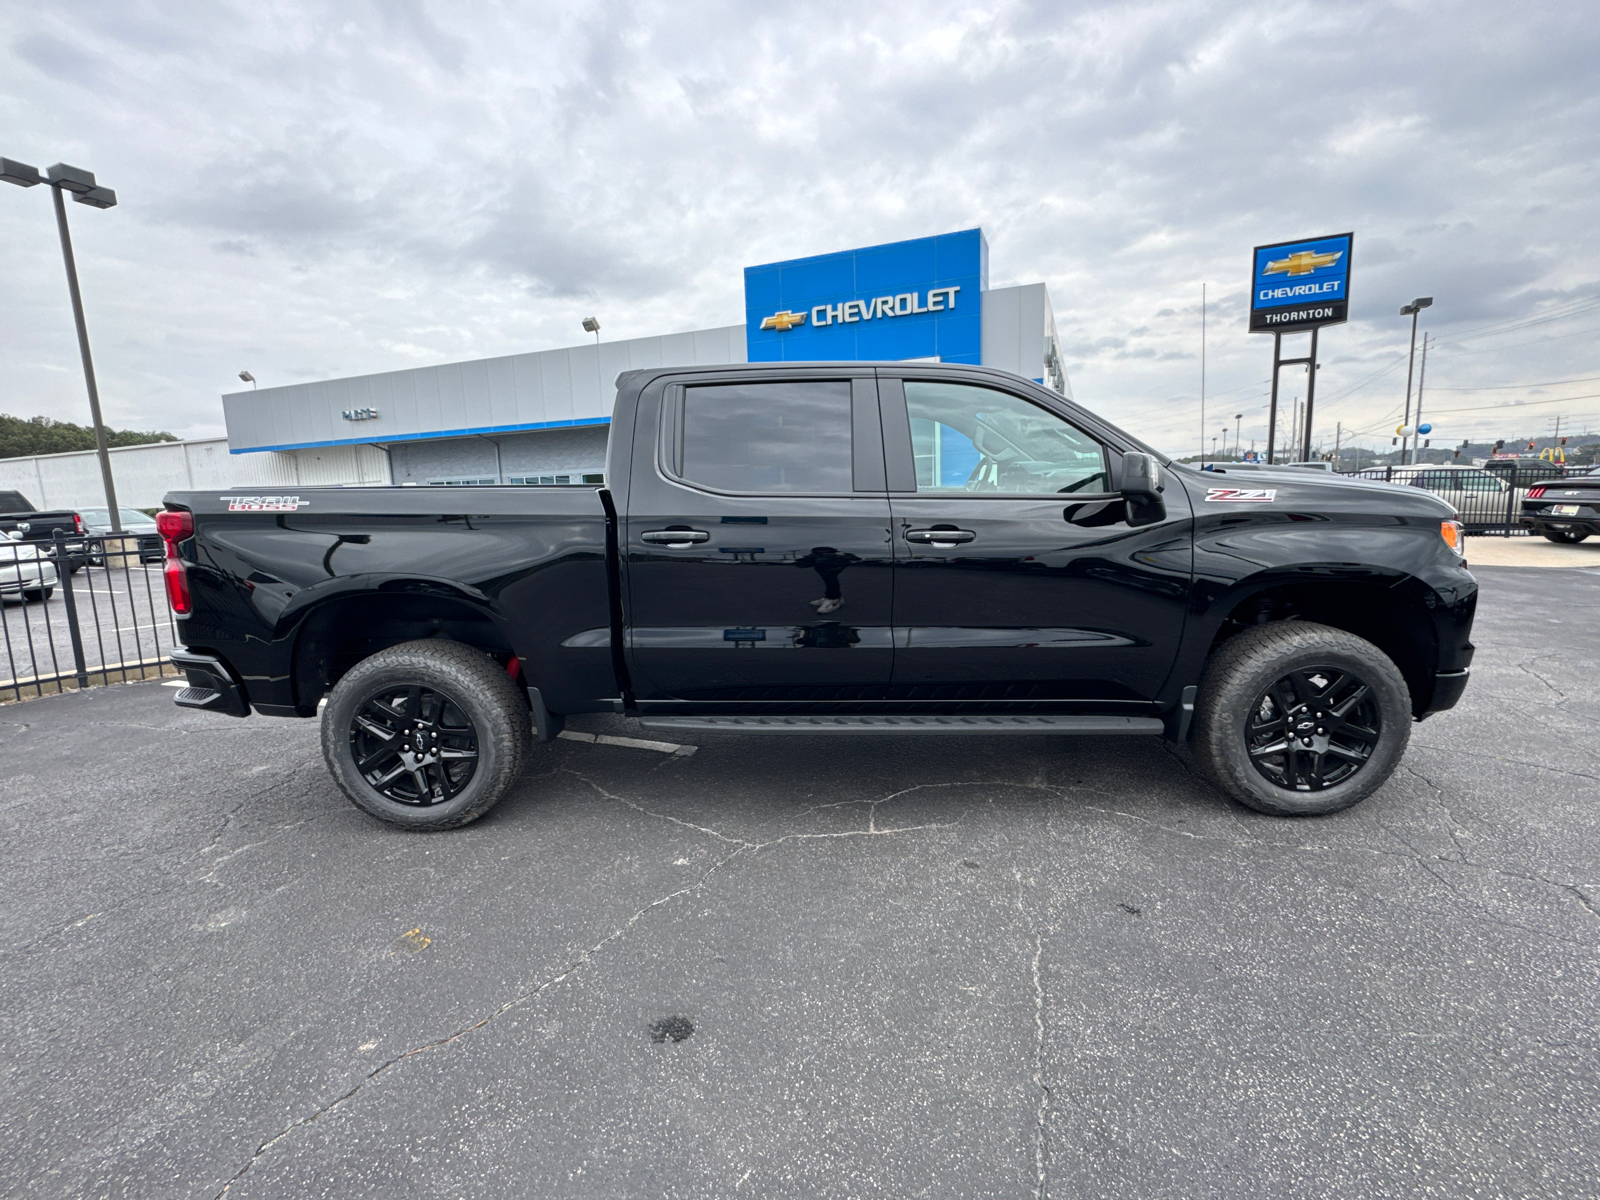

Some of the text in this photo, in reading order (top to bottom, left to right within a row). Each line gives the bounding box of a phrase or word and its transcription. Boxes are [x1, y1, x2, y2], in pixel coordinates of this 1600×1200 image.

[1259, 280, 1342, 300] CHEVROLET
[811, 286, 961, 327] CHEVROLET
[1265, 307, 1333, 324] THORNTON
[1204, 487, 1278, 503] Z71
